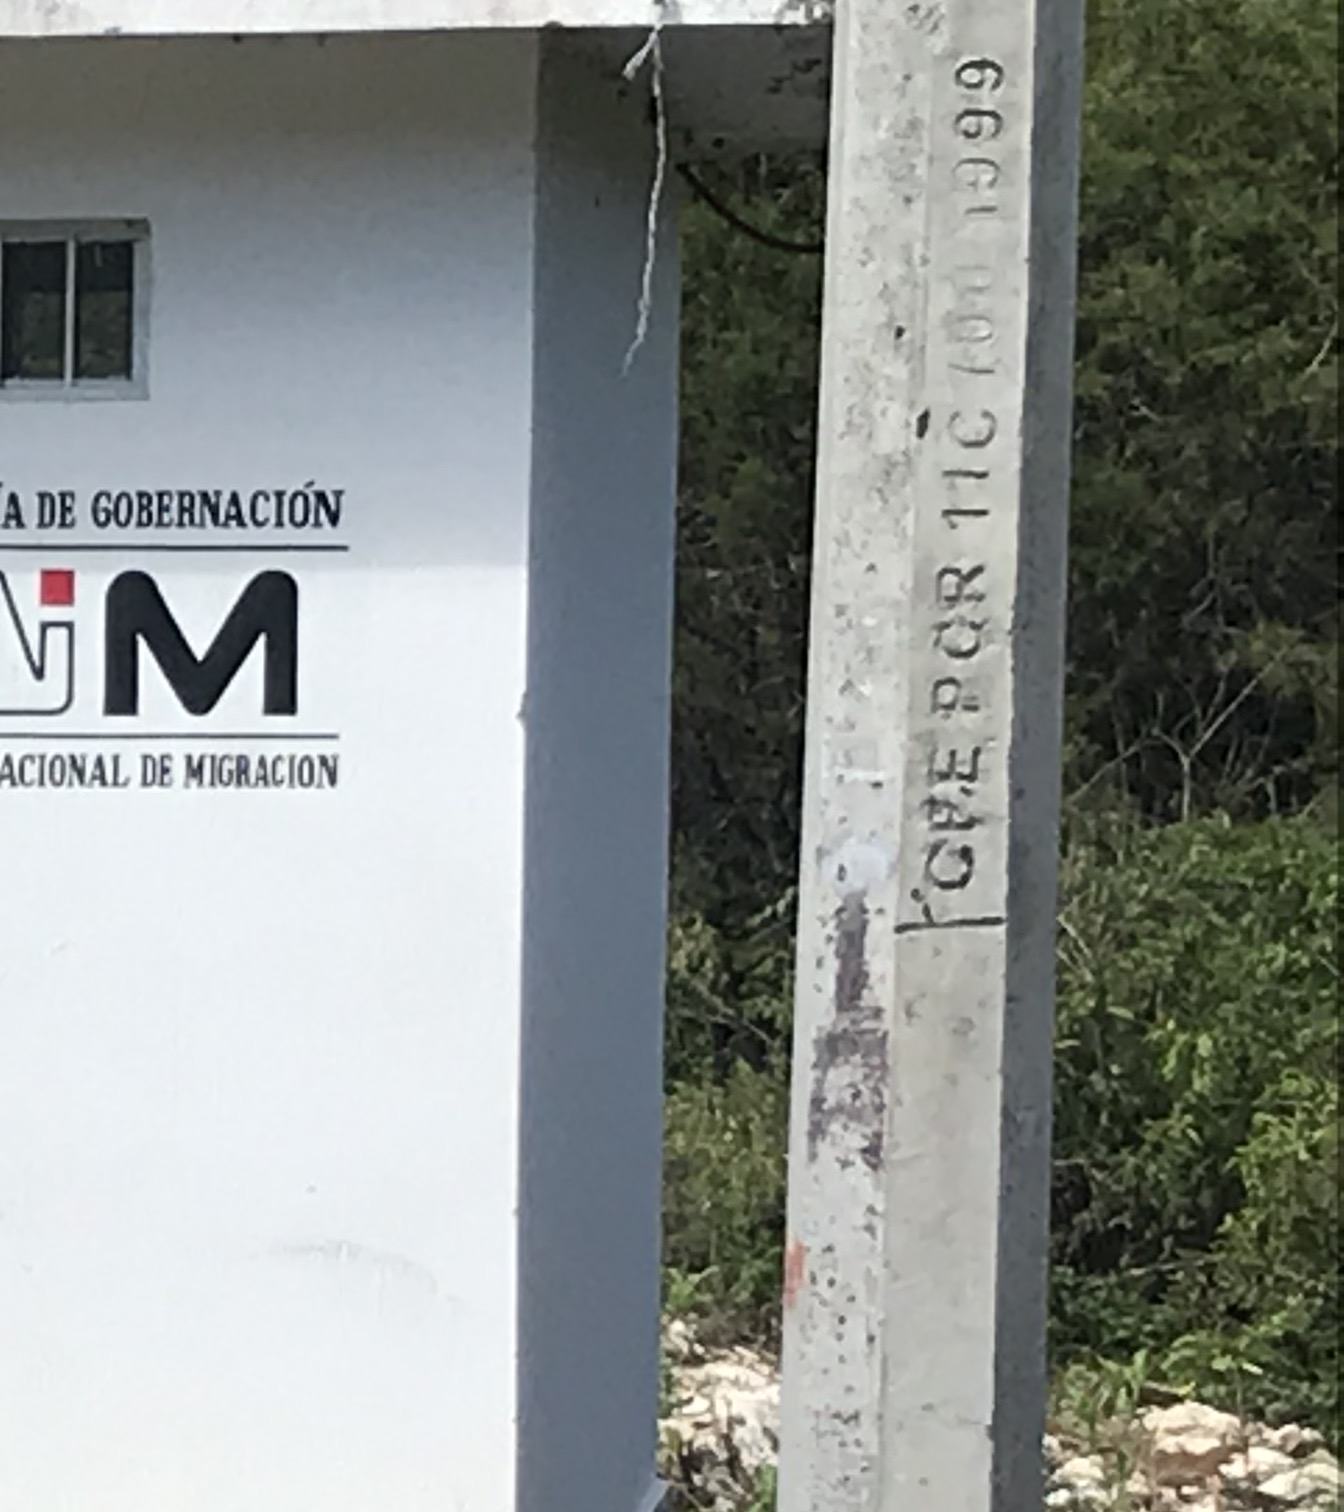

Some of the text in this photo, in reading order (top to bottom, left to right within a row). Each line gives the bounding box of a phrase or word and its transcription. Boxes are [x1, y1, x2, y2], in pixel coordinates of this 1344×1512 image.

[37, 490, 76, 529] DE
[91, 481, 345, 529] GOBERNACIÓN
[140, 752, 173, 788] DE
[184, 752, 340, 789] MIGRACION
